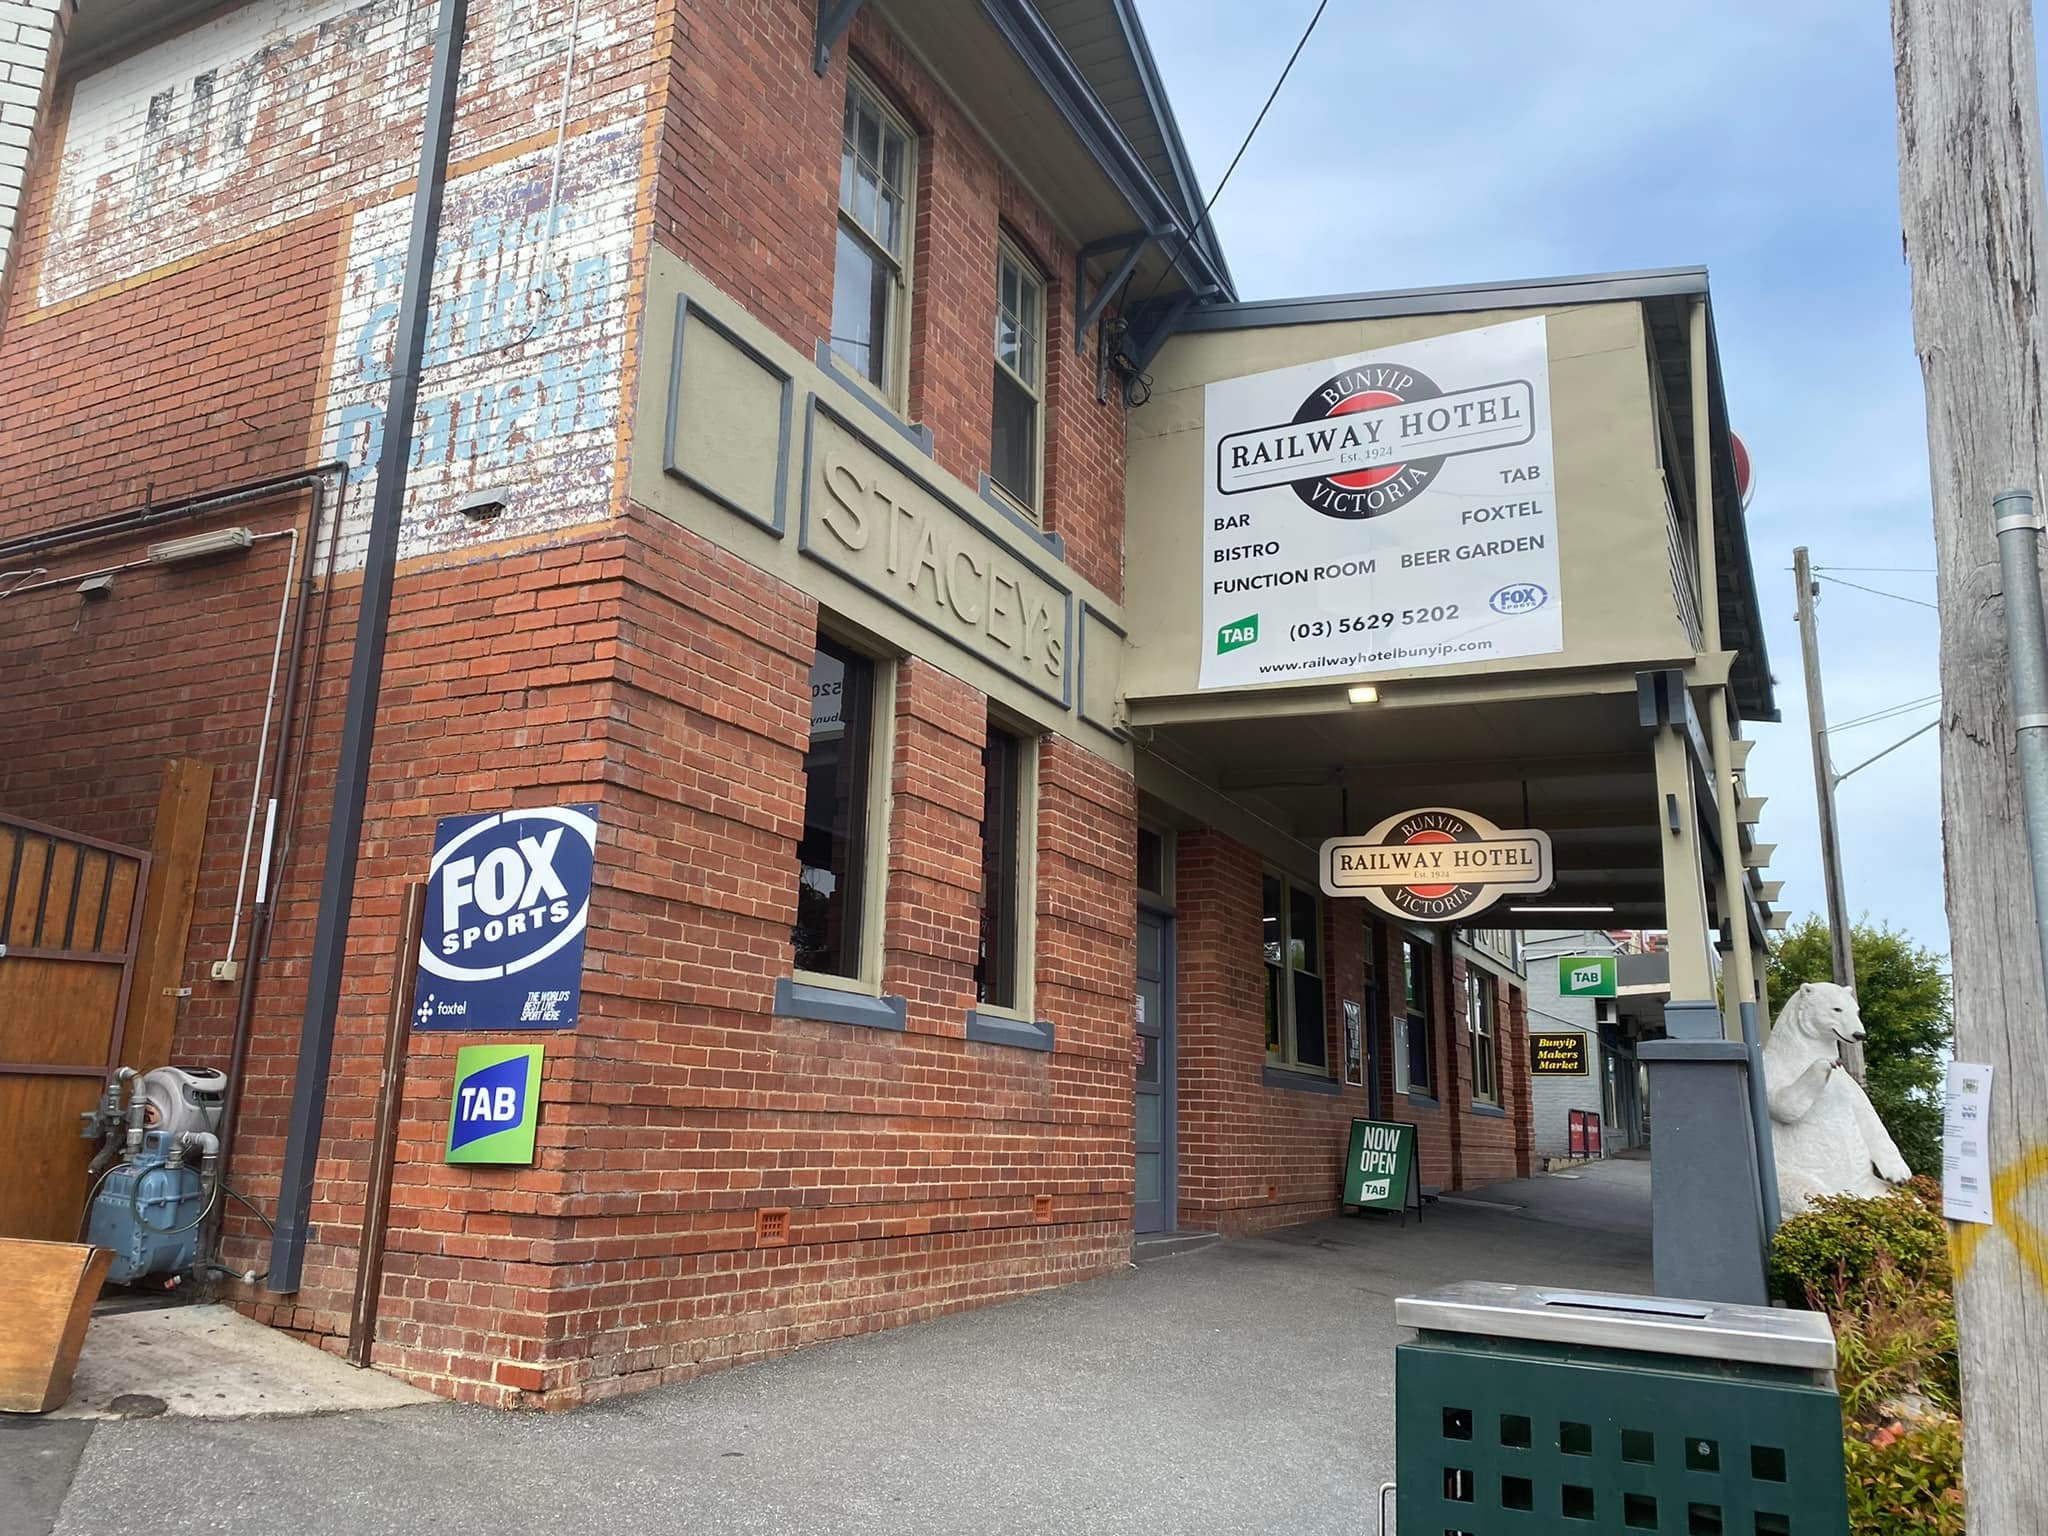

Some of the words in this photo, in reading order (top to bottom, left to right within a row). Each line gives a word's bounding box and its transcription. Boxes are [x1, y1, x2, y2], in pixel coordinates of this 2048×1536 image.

[1321, 368, 1413, 407] BUNYIP
[1231, 419, 1384, 469] RAILWAY
[1400, 396, 1520, 438] HOTEL
[1340, 451, 1361, 464] Est.
[1364, 446, 1393, 460] 1924
[1500, 466, 1540, 484] TAB
[1312, 465, 1428, 513] VICTORIA
[1214, 514, 1250, 531] BAR
[1462, 501, 1543, 525] FOXTEL
[1214, 541, 1280, 563] BISTRO
[1401, 549, 1450, 568] BEER
[1456, 535, 1544, 560] GARDEN
[1214, 569, 1308, 594] FUNCTION
[1314, 559, 1376, 580] ROOM
[1501, 588, 1536, 605] FOX
[1290, 621, 1332, 642] (03)
[1339, 613, 1394, 633] 5629
[1402, 604, 1459, 625] 5202
[1221, 628, 1254, 644] TAB
[1259, 640, 1492, 673] www.railwayhotelbunyip.com
[1401, 815, 1463, 837] BUNYIP
[1341, 852, 1443, 871] RAILWAY
[1455, 848, 1532, 867] HOTEL
[442, 826, 569, 932] FOX
[1414, 871, 1428, 879] Est.
[1394, 887, 1472, 913] VICTORIA
[442, 900, 570, 955] SPORTS
[1574, 972, 1598, 983] TAB
[524, 1001, 541, 1010] BEST
[541, 1001, 556, 1010] LIVE
[528, 992, 540, 1001] THE
[540, 990, 570, 1001] WORLD'S
[437, 1001, 467, 1015] foxtel
[520, 1011, 541, 1020] SPORT
[542, 1010, 561, 1020] HERE
[1539, 1038, 1576, 1048] Bunyip
[1538, 1050, 1578, 1059] Makers
[1539, 1060, 1578, 1069] Market
[461, 1086, 516, 1121] TAB
[1363, 1126, 1400, 1152] NOW
[1360, 1150, 1396, 1175] OPEN
[1365, 1184, 1386, 1196] TAB
